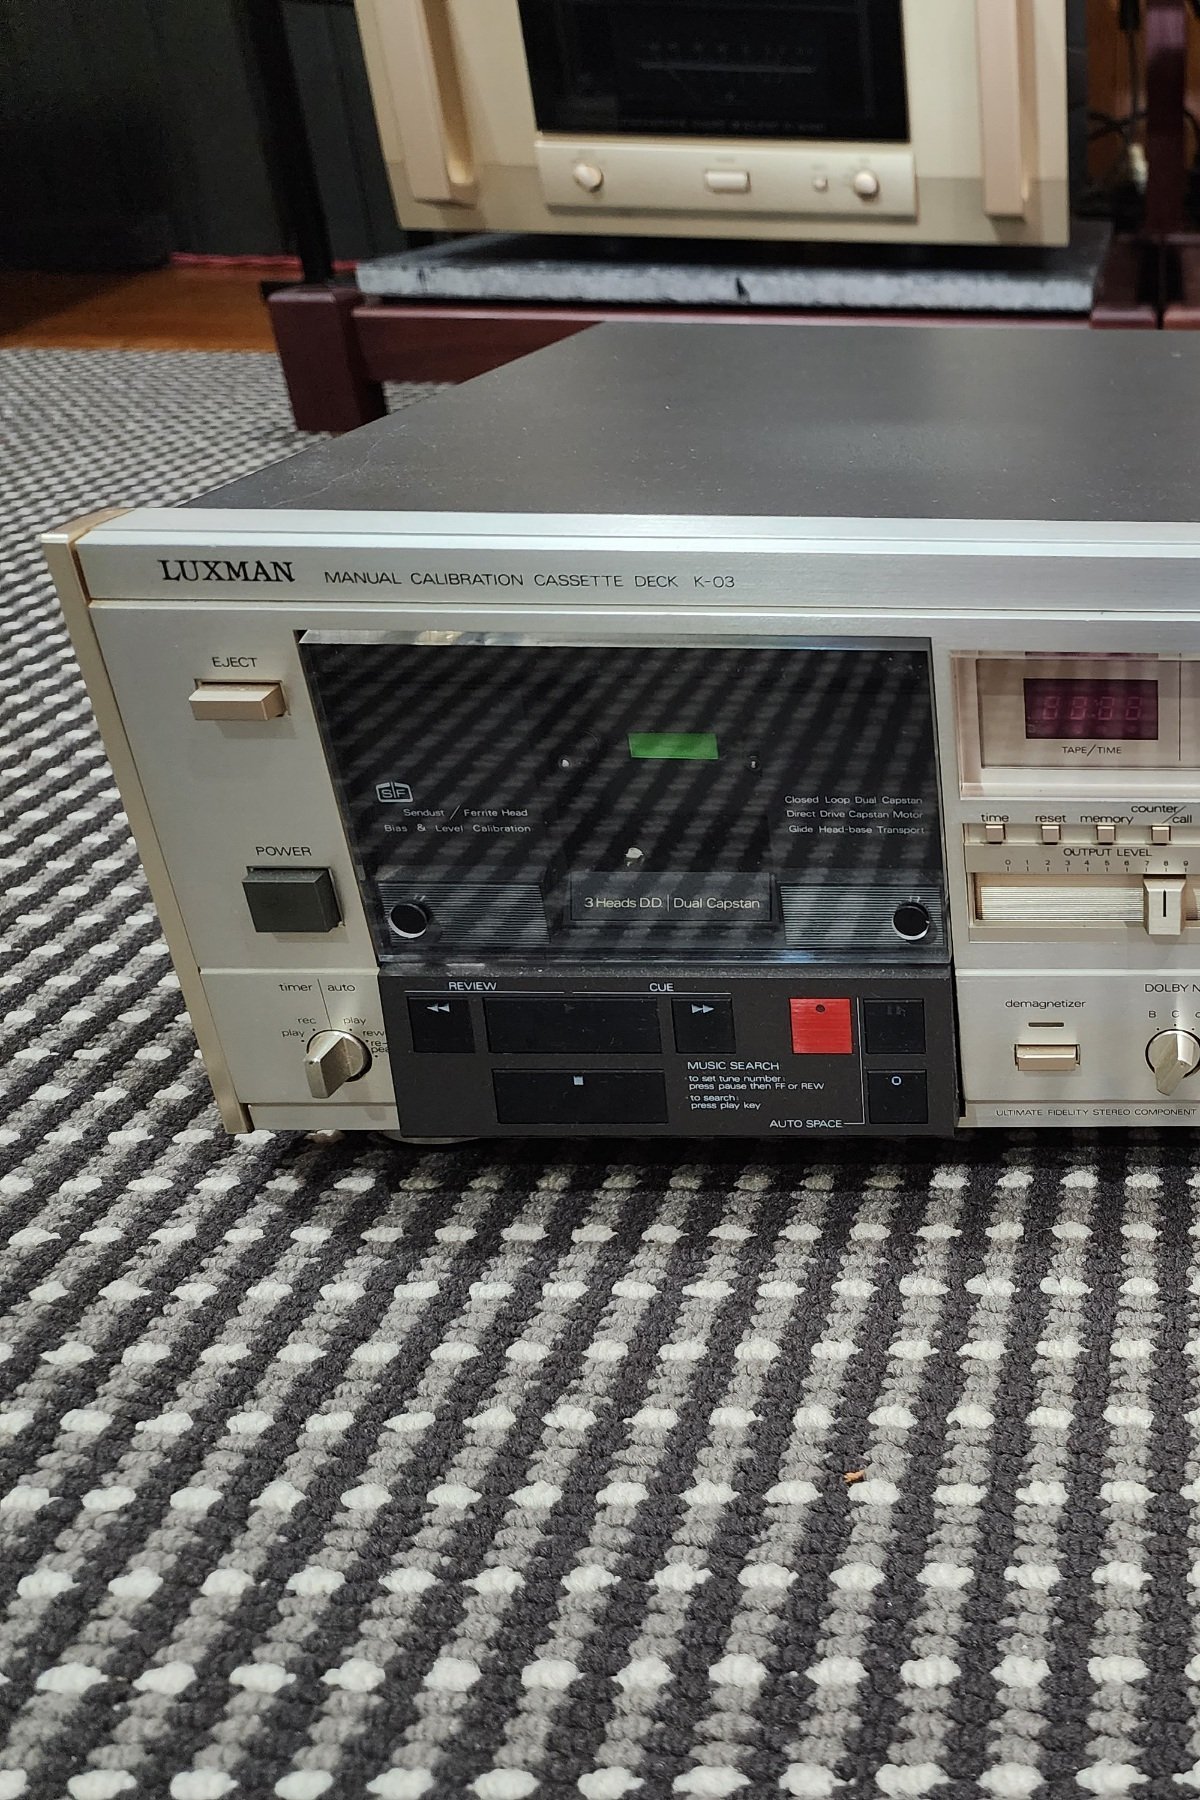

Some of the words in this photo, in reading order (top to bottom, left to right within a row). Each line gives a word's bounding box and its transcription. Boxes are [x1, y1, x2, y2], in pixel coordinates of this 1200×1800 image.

[158, 559, 296, 582] LUXMAN
[324, 571, 402, 586] MANUAL
[410, 572, 524, 587] CALIBRATION
[533, 573, 624, 588] CASSETTE
[634, 575, 679, 588] DECK
[693, 575, 736, 589] K-03
[212, 656, 258, 669] EJECT
[784, 796, 819, 804] Closed
[825, 796, 850, 805] Loop
[855, 796, 877, 804] Dual
[882, 796, 922, 806] Capstan
[403, 809, 445, 817] Sendust
[464, 809, 498, 817] Ferrite
[502, 809, 528, 817] Head
[786, 810, 816, 818] Direct
[820, 810, 845, 818] Drive
[849, 811, 889, 819] Capstan
[893, 811, 924, 819] Motor
[981, 813, 1009, 823] time
[1035, 815, 1066, 823] reset
[1080, 815, 1134, 825] memory
[1173, 815, 1192, 824] call
[417, 824, 426, 832] &
[789, 825, 813, 833] Glide
[819, 826, 872, 834] Head-base
[877, 826, 925, 835] Transport
[255, 846, 312, 857] POWER
[1063, 848, 1112, 857] OUTPUT
[1117, 849, 1152, 857] LEVEL
[584, 898, 594, 909] 3
[596, 897, 637, 909] Heads
[673, 897, 703, 909] Dual
[706, 898, 760, 912] Capstan
[279, 983, 312, 991] timer
[328, 984, 355, 992] auto
[448, 982, 497, 991] REVIEW
[649, 983, 674, 991] CUE
[1144, 983, 1190, 993] DOLBY
[1005, 999, 1086, 1009] demagnetizer
[1148, 1010, 1157, 1019] B
[343, 1017, 367, 1025] play
[282, 1029, 305, 1037] play
[688, 1062, 726, 1070] MUSIC
[730, 1062, 780, 1070] SEARCH
[691, 1102, 716, 1110] press
[720, 1102, 740, 1110] play
[744, 1102, 761, 1110] key
[996, 1108, 1043, 1116] ULTIMATE
[1047, 1108, 1089, 1116] FIDELITY
[1092, 1108, 1130, 1116] STEREO
[1135, 1108, 1197, 1116] COMPONENT
[769, 1119, 803, 1128] AUTO
[806, 1119, 842, 1128] SPACE
